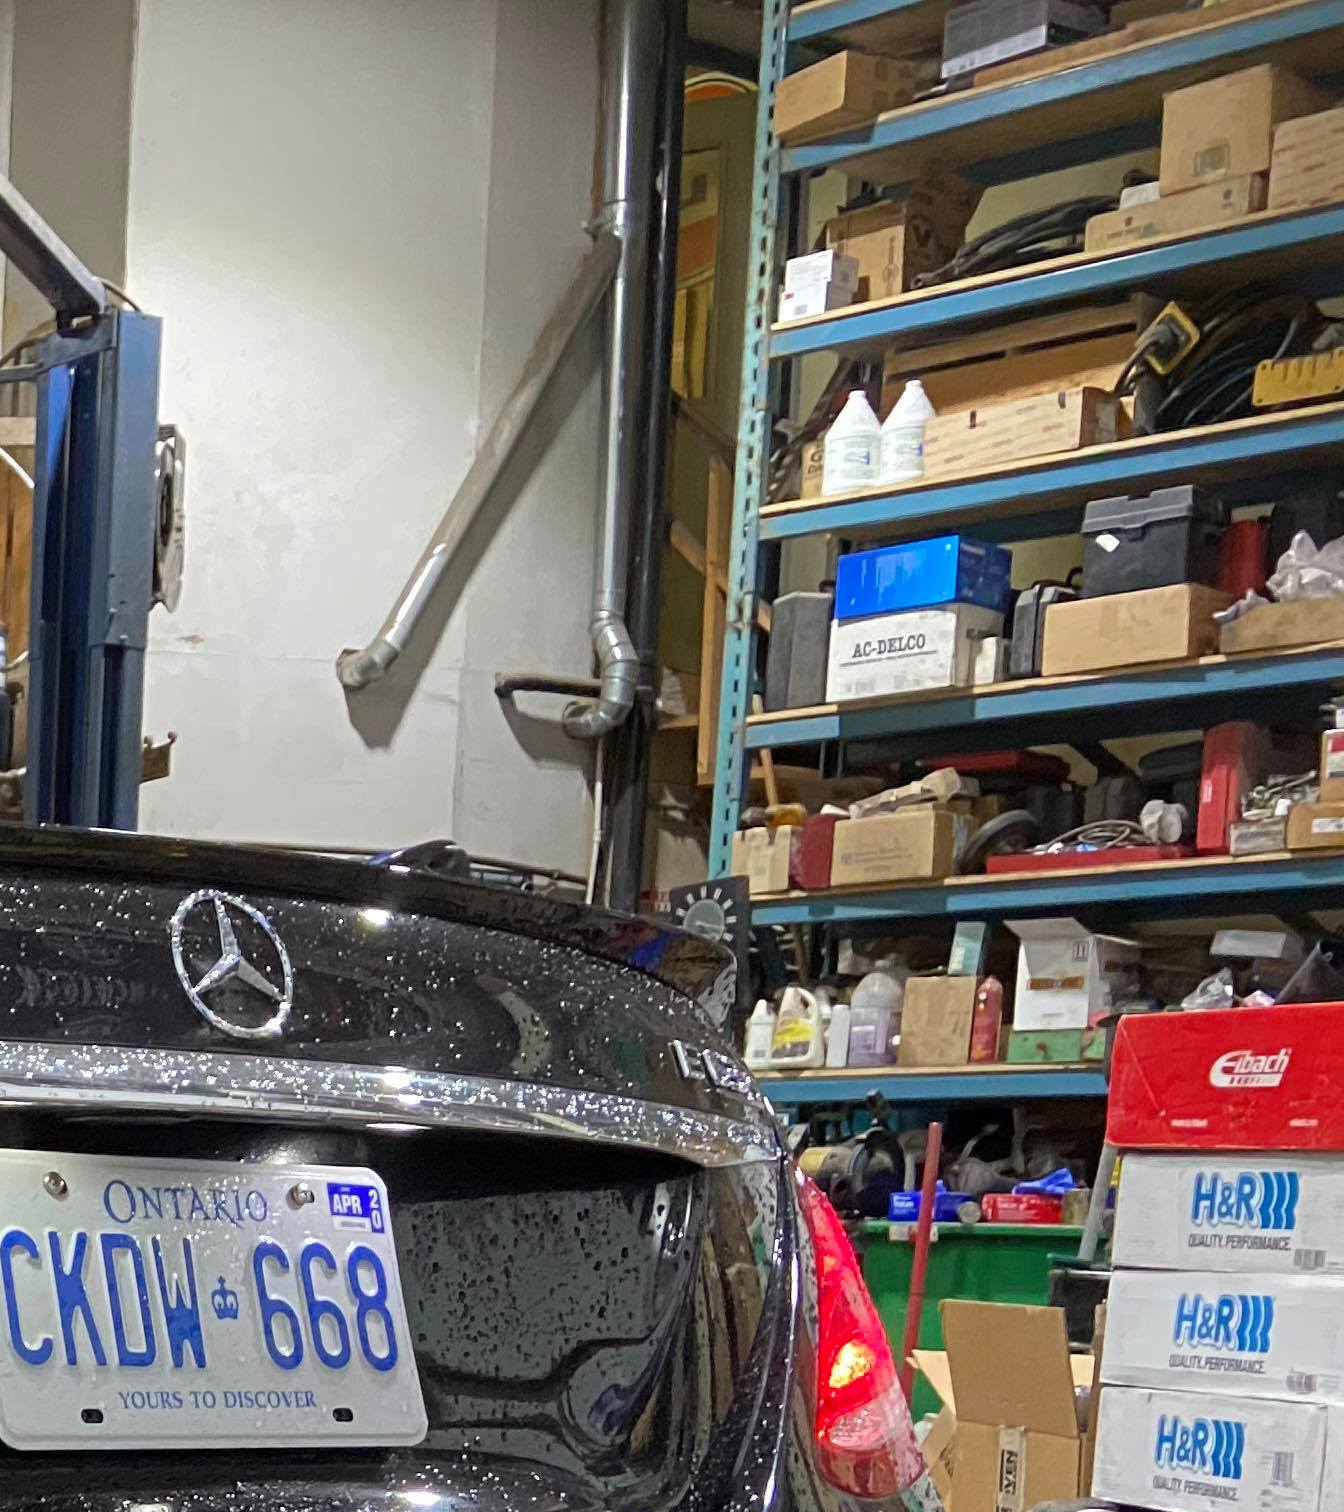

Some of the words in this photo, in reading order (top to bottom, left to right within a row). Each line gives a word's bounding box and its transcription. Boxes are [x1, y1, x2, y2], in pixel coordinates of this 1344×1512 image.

[852, 633, 927, 659] AC-DELCO
[1210, 1048, 1292, 1087] Eibach
[333, 1193, 363, 1215] APR
[1191, 1170, 1258, 1223] H&R
[0, 1229, 207, 1369] CKDW
[252, 1241, 399, 1372] 668
[1173, 1293, 1235, 1345] H&R
[118, 1390, 184, 1410] YOURS
[190, 1391, 217, 1410] TO
[223, 1390, 318, 1410] DISCOVER
[1155, 1414, 1211, 1468] H&R
